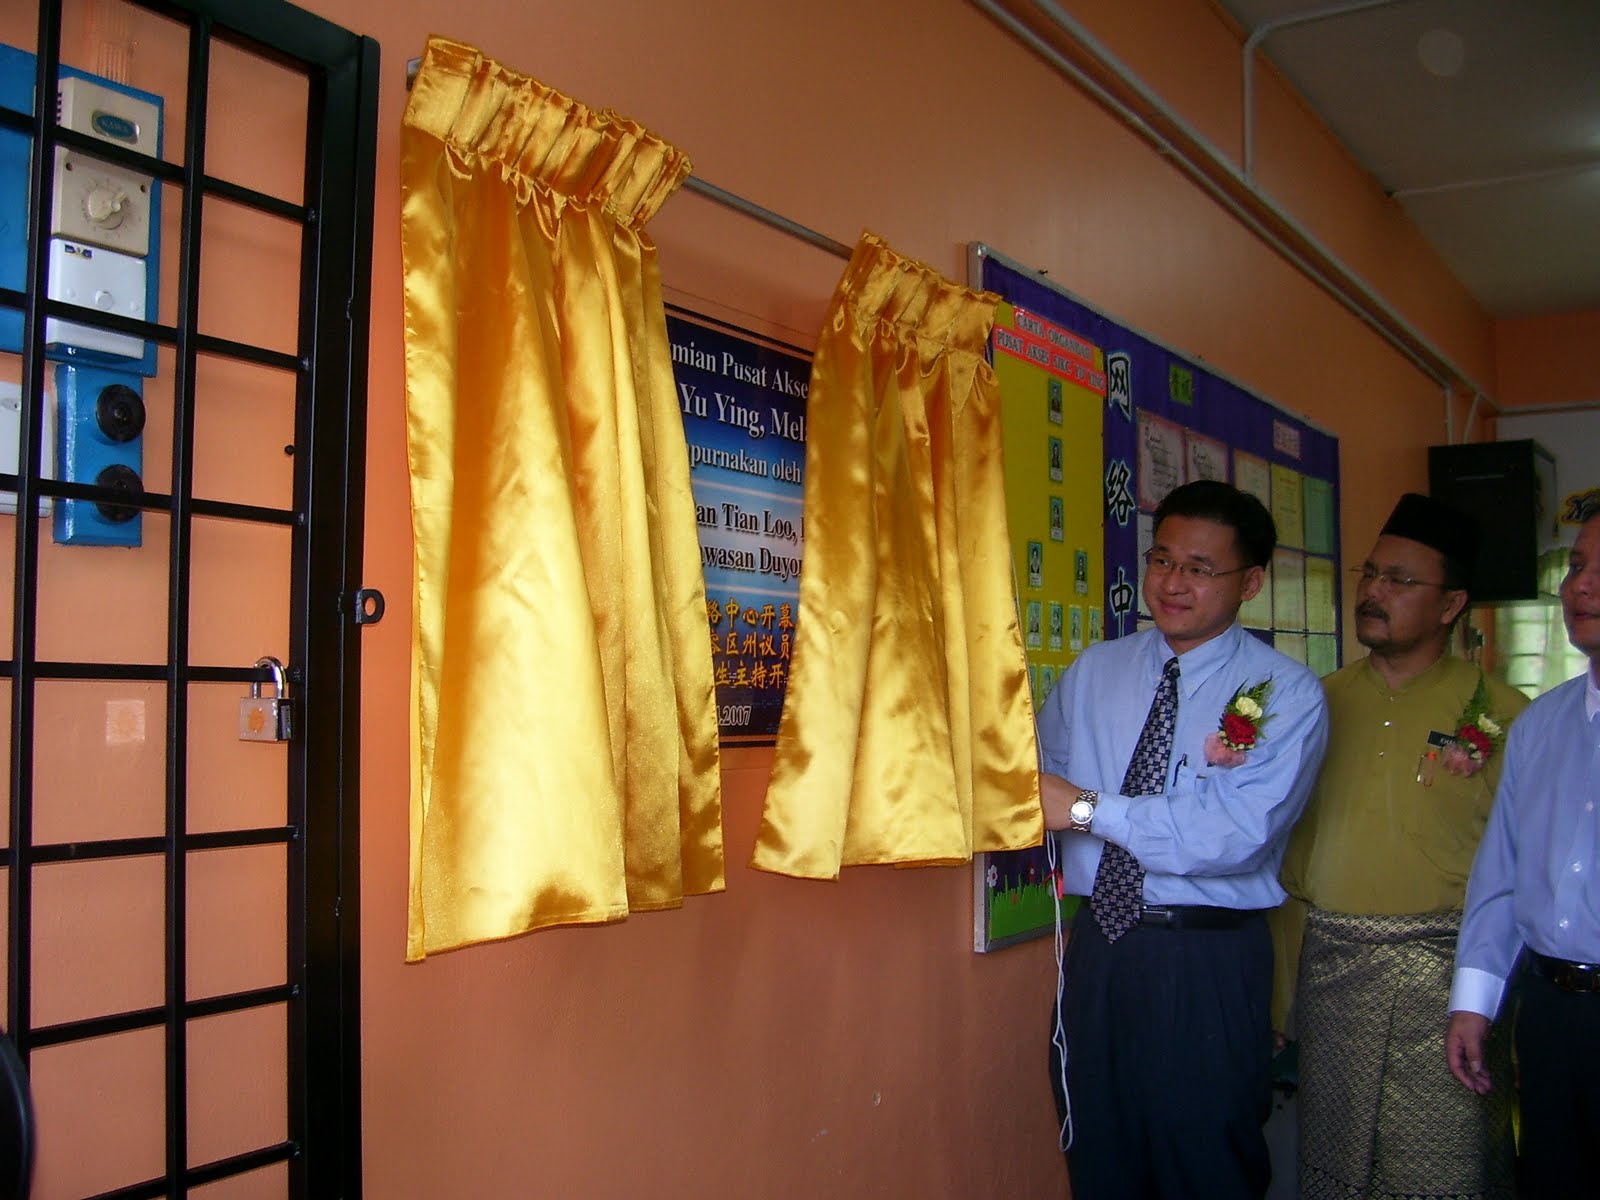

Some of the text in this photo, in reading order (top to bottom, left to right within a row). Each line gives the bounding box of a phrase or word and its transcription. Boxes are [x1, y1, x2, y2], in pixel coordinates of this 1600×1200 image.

[996, 329, 1024, 353] PUSAT
[669, 341, 809, 400] mian Pusat Akse
[678, 383, 808, 443] Yu Ying, Mel
[686, 443, 801, 484] purnakan oleh
[722, 503, 758, 531] Tian
[763, 510, 797, 543] Loo,
[699, 545, 754, 569] wasan
